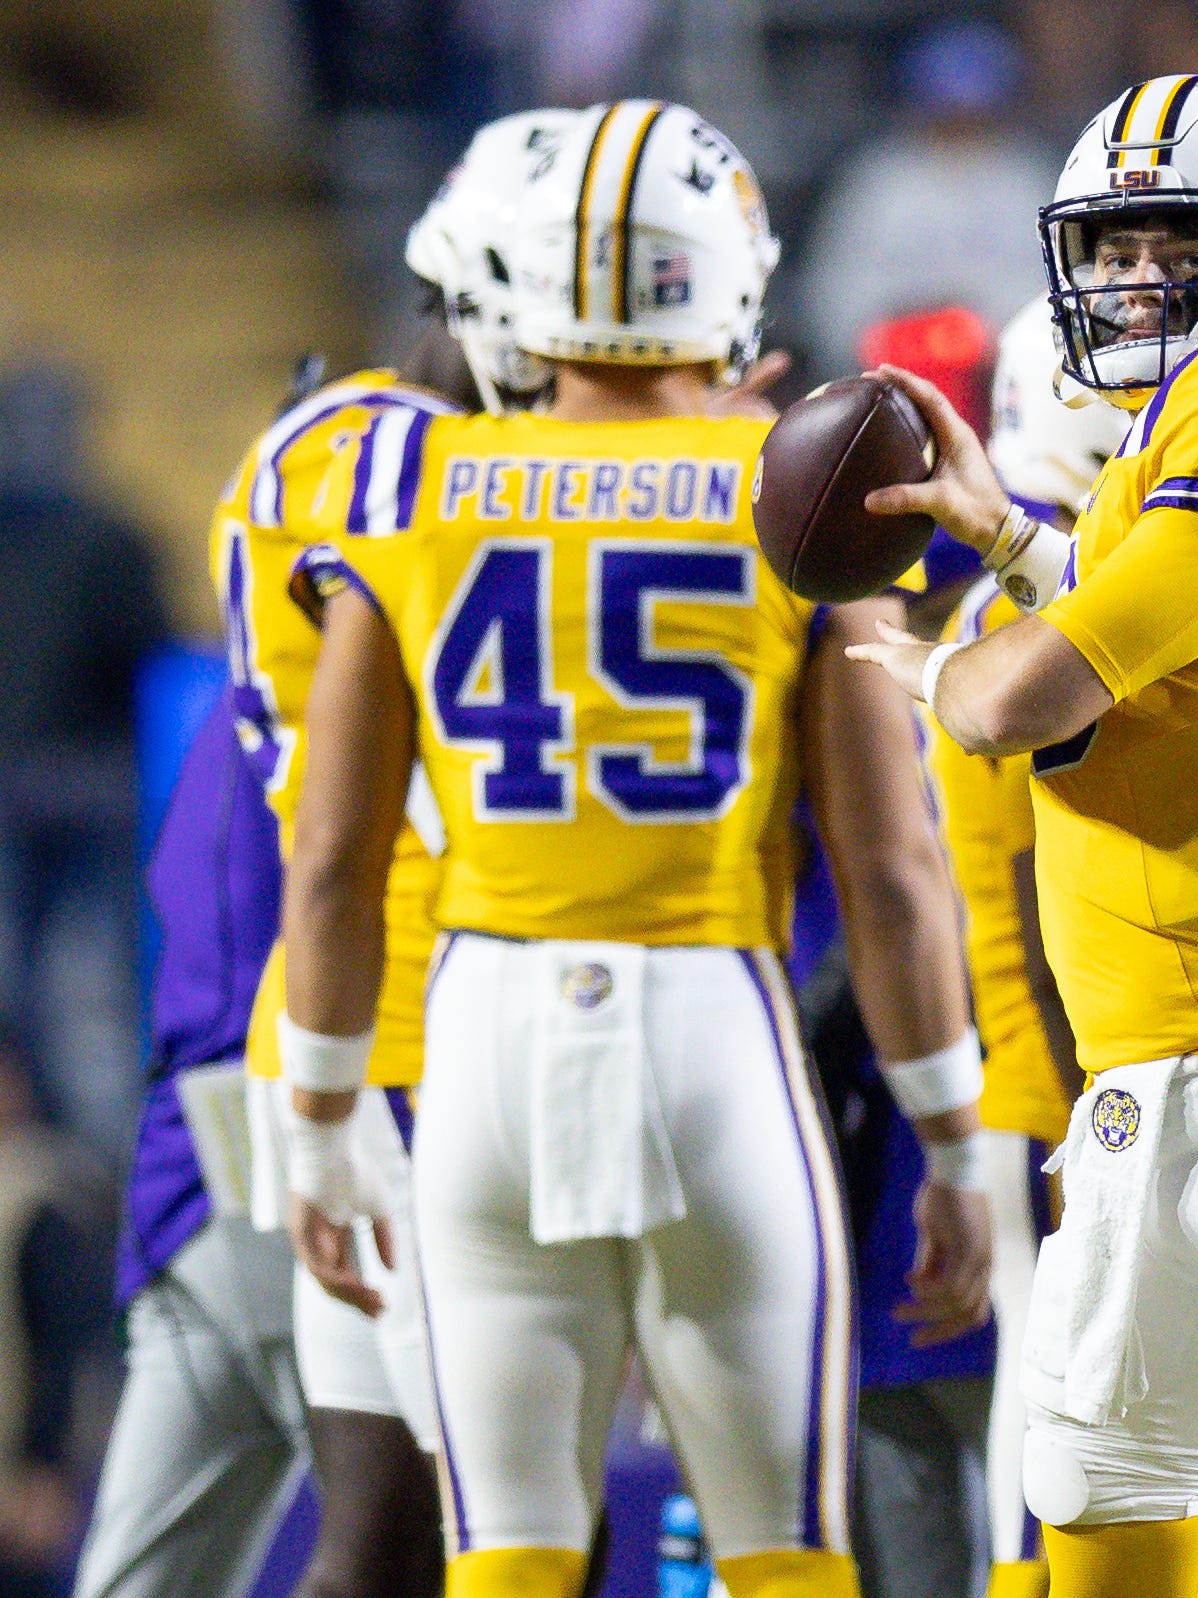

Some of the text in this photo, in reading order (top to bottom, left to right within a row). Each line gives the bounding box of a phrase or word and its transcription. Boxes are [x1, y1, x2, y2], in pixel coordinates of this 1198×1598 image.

[1109, 170, 1160, 189] LSU
[440, 457, 741, 524] PETERSON
[424, 537, 757, 824] 45
